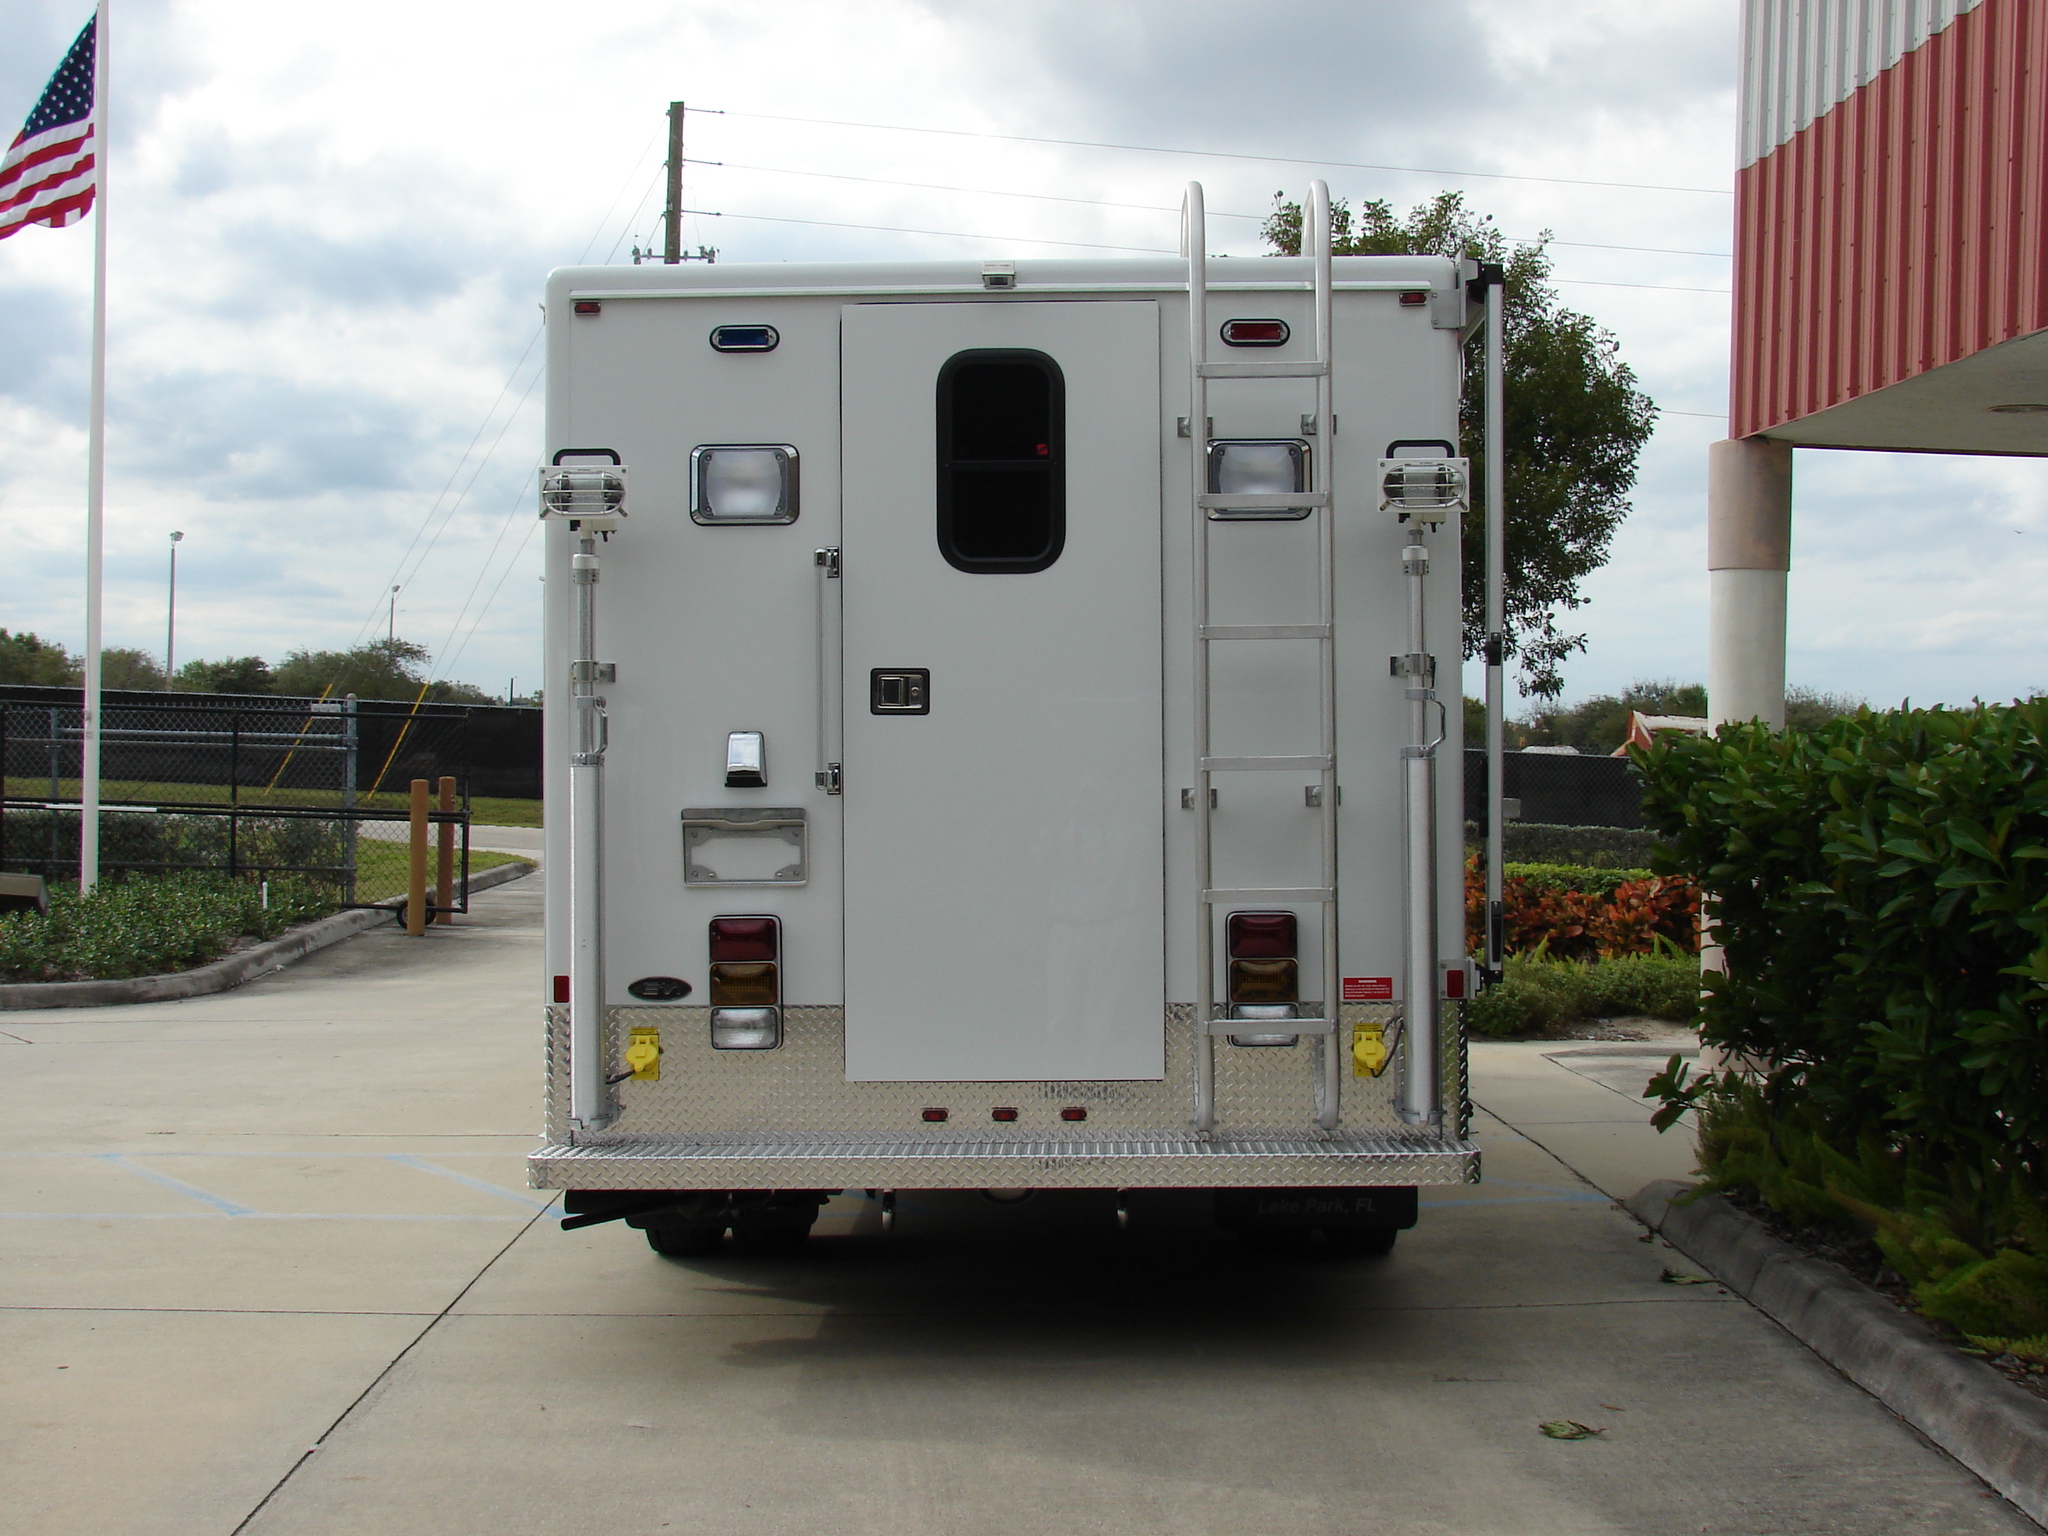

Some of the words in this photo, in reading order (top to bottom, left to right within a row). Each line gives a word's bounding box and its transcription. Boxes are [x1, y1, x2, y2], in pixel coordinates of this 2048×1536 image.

[1257, 1199, 1300, 1215] Lake
[1304, 1198, 1349, 1215] Park,
[1355, 1197, 1377, 1213] FL
